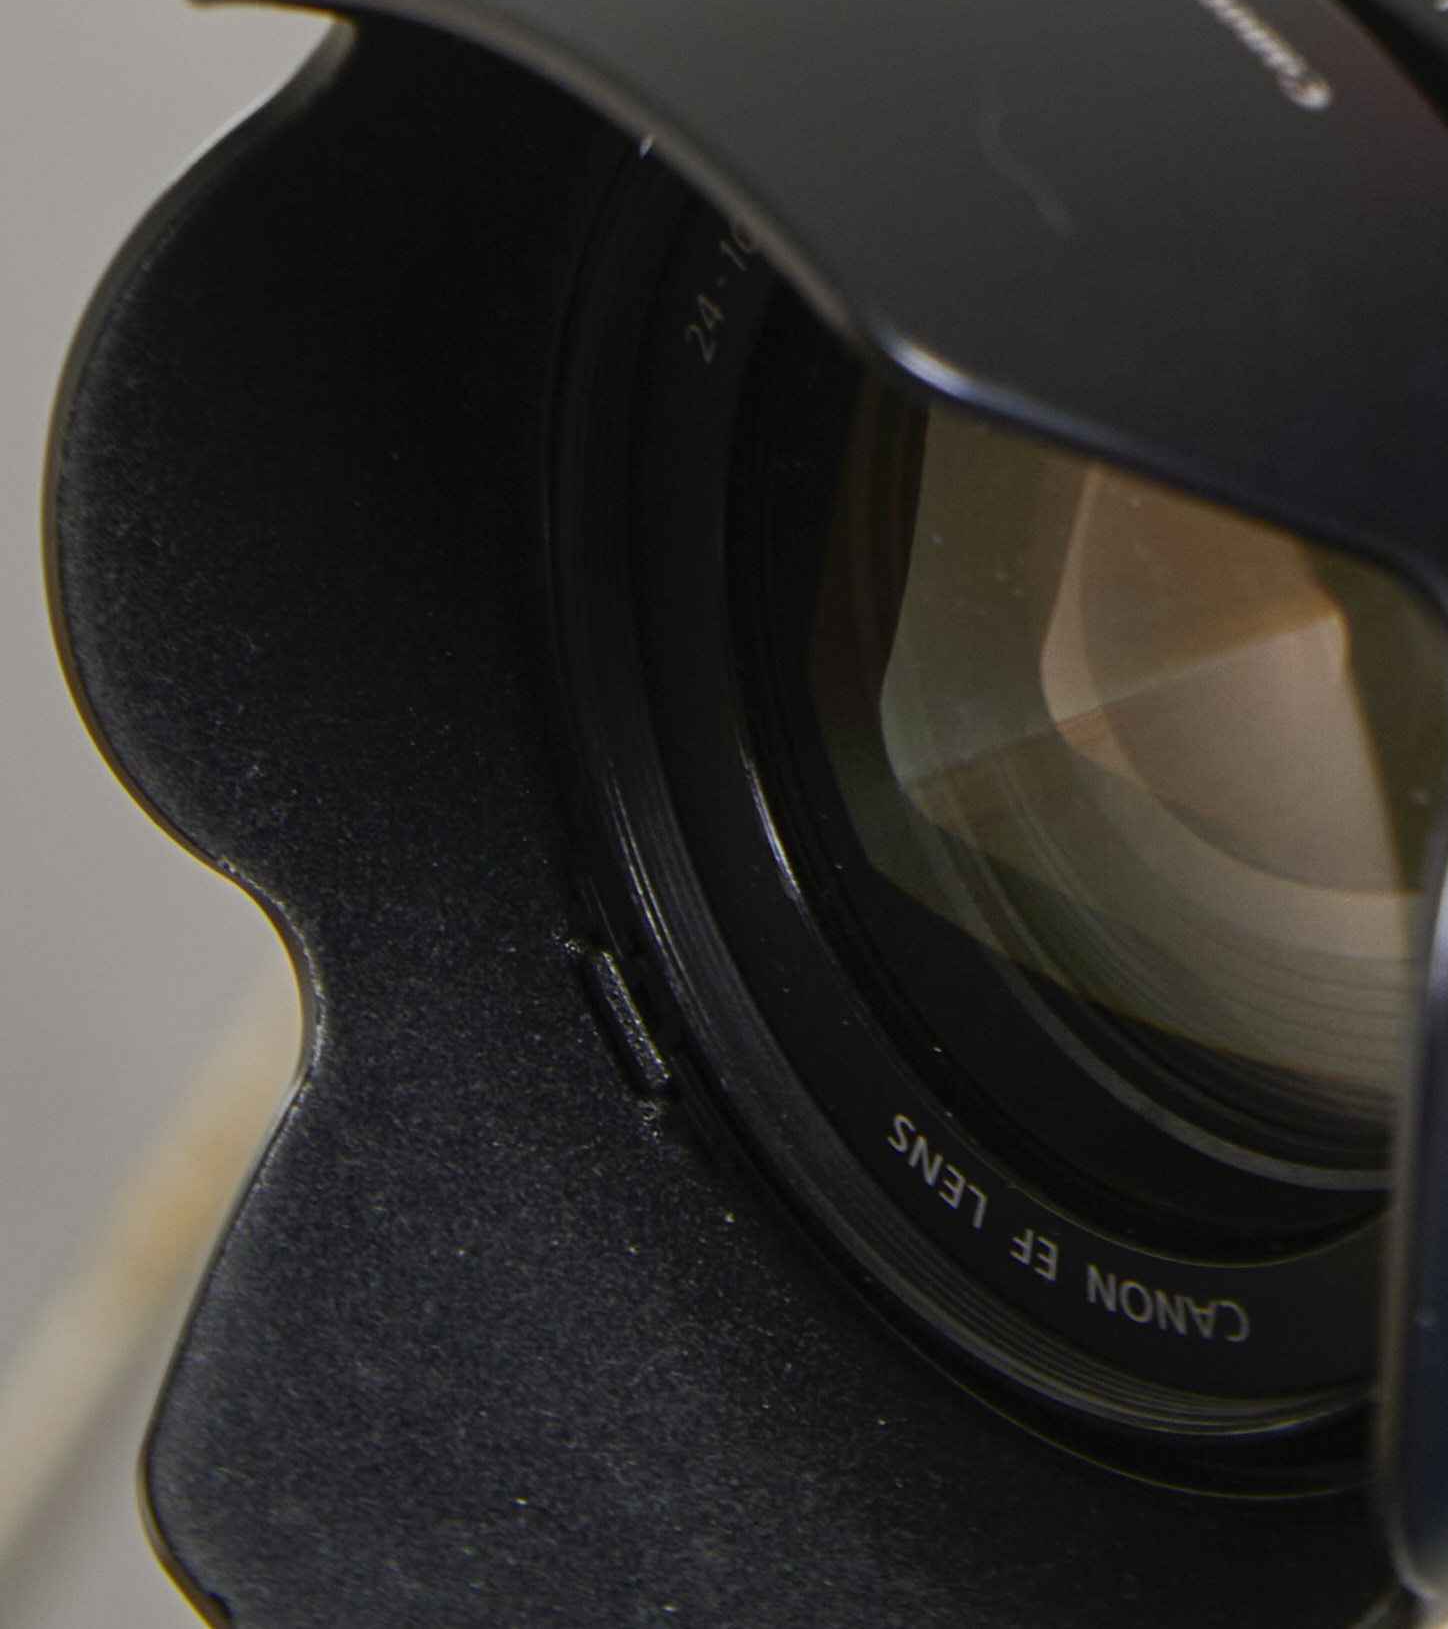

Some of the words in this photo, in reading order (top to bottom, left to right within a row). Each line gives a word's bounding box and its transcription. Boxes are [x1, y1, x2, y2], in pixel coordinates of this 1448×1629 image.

[887, 1114, 989, 1230] LENS
[1009, 1228, 1059, 1282] EF
[1085, 1264, 1250, 1344] CANON
